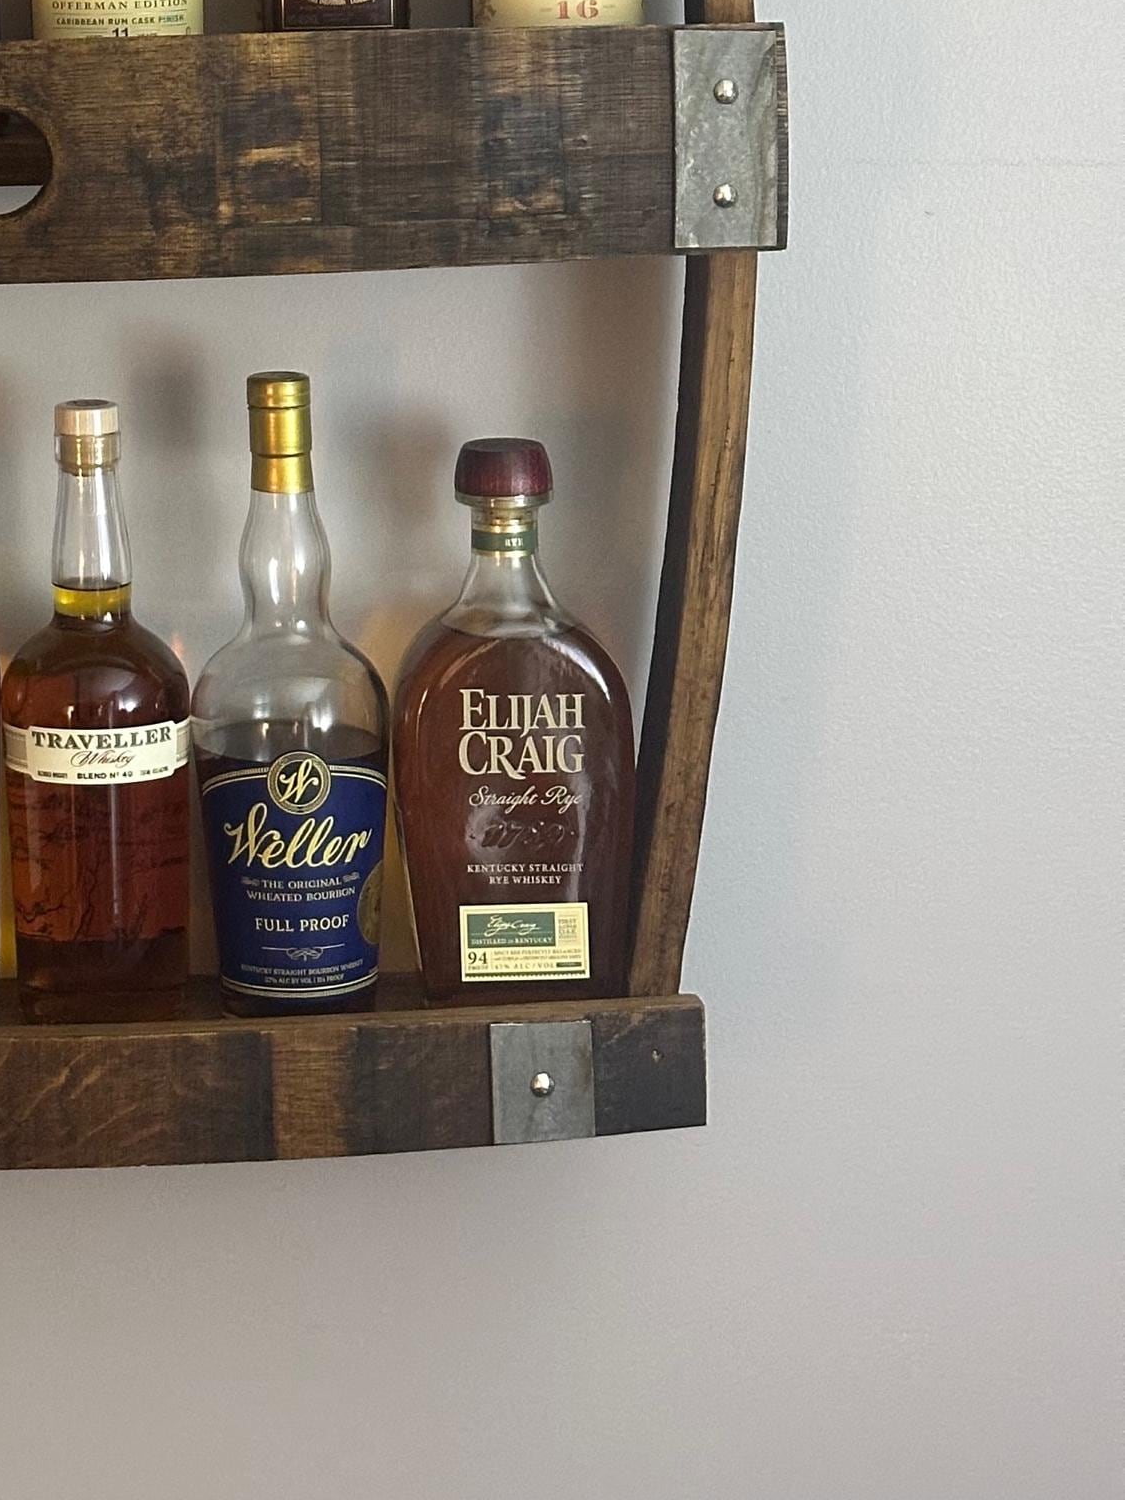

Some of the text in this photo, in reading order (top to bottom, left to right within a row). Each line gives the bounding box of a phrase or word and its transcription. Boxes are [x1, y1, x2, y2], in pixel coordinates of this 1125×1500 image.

[52, 0, 128, 10] OFFERMAN
[557, 0, 599, 20] 16
[56, 16, 105, 26] CARIBBEAN
[108, 16, 128, 25] RUM
[131, 16, 155, 24] CASK
[459, 689, 586, 738] ELIJAH
[31, 726, 172, 750] TRAVELLER
[458, 731, 585, 780] CRAIG
[77, 772, 106, 780] BLEND
[469, 785, 581, 814] Straight Rye
[224, 802, 373, 869] Weller
[467, 863, 584, 873] KENTUCKY STRAIGHT
[262, 877, 342, 889] THE ORIGINAL
[489, 875, 562, 884] RYE WHISKEY
[246, 886, 356, 902] WHEATED BOURBON
[255, 914, 350, 932] FULL PROOF
[515, 936, 553, 944] KENTUCKY
[468, 951, 488, 965] 94
[273, 968, 307, 976] STRAIGHT
[308, 966, 339, 975] BOURBON
